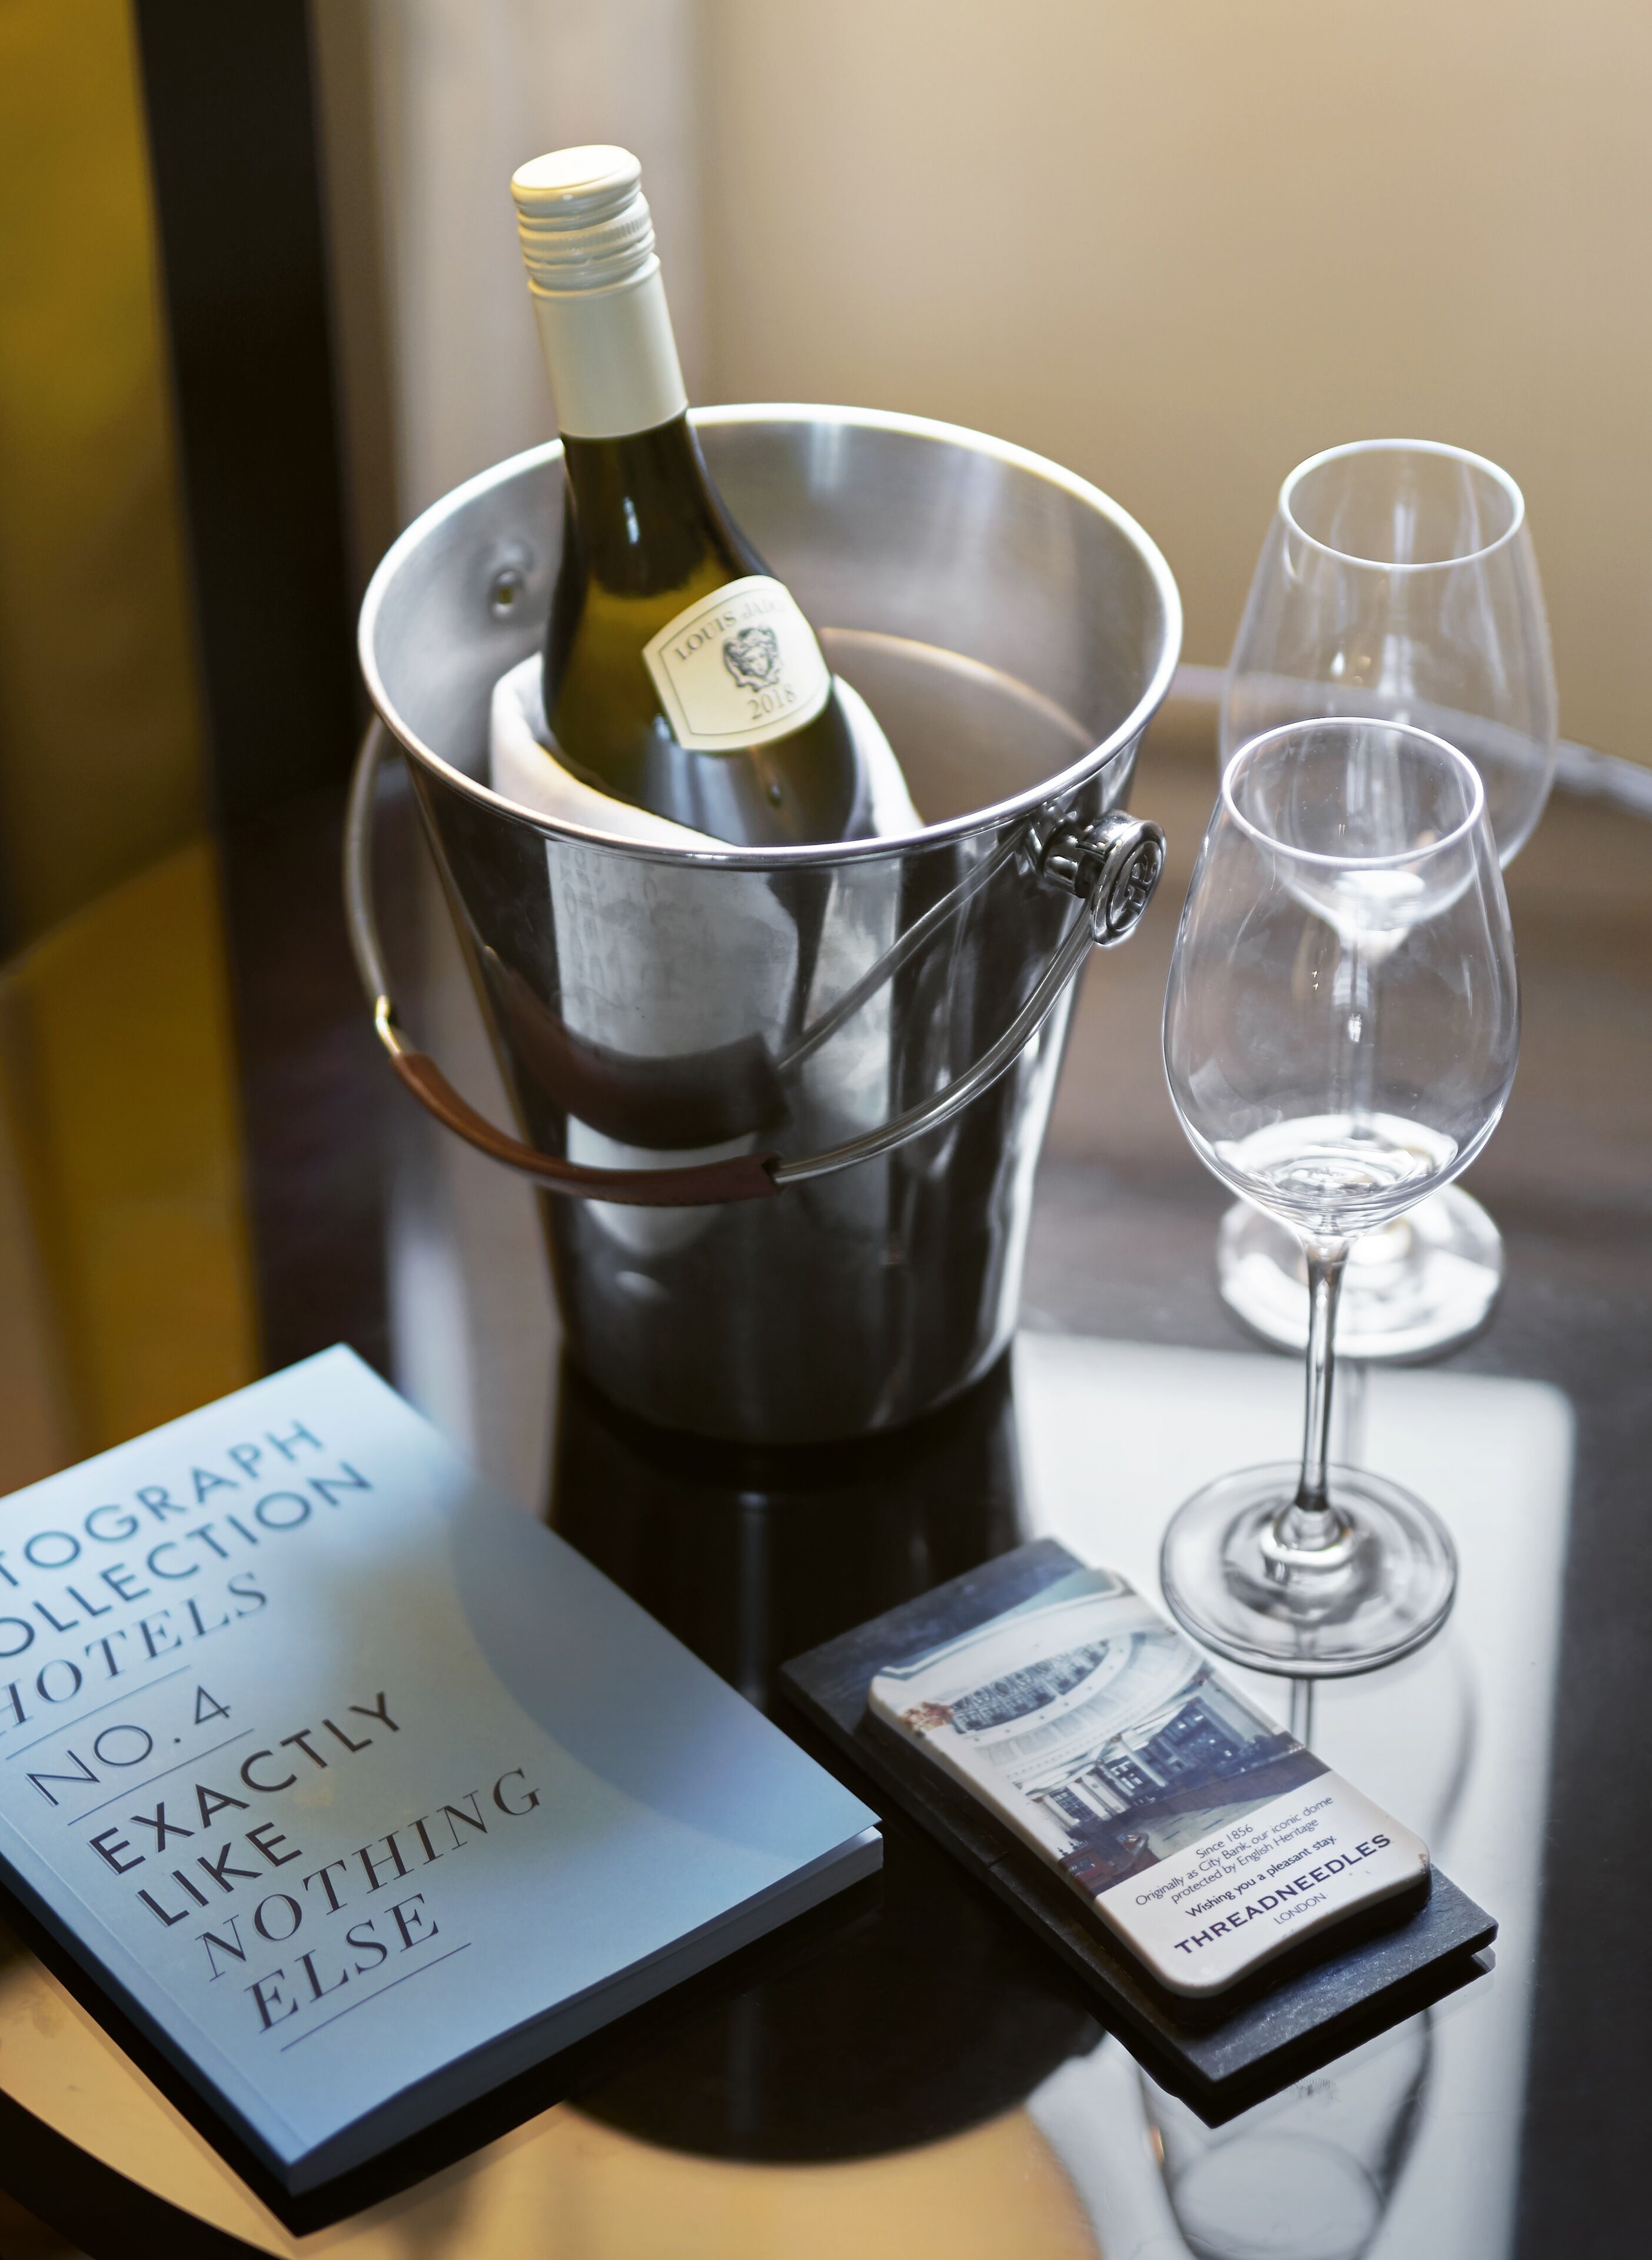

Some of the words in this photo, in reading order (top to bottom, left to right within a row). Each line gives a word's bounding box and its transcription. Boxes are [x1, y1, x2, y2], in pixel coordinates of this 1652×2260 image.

[674, 611, 736, 661] LOUIS
[747, 684, 797, 720] 2018
[193, 1684, 230, 1726] 4
[88, 1691, 401, 1875] EXACTLY
[137, 1822, 303, 1926] LIKE
[195, 1767, 540, 1982] NOTHING
[1135, 1875, 1185, 1906] Originally
[1186, 1870, 1199, 1880] as
[1198, 1856, 1221, 1872] City
[1251, 1830, 1269, 1844] our
[1271, 1813, 1302, 1833] iconic
[1302, 1796, 1334, 1817] dome
[1171, 1869, 1223, 1905] protected
[1222, 1861, 1237, 1875] by
[1236, 1843, 1274, 1866] English
[1272, 1818, 1319, 1846] Heritage
[1185, 1890, 1236, 1917] Wishing
[1234, 1878, 1257, 1896] you
[1266, 1847, 1313, 1878] pleasant
[1312, 1834, 1338, 1852] stay.
[1195, 1840, 1225, 1859] Since
[1226, 1823, 1254, 1843] 1856
[1174, 1834, 1392, 1955] THREADNEEDLES
[243, 1892, 440, 2033] ELSE
